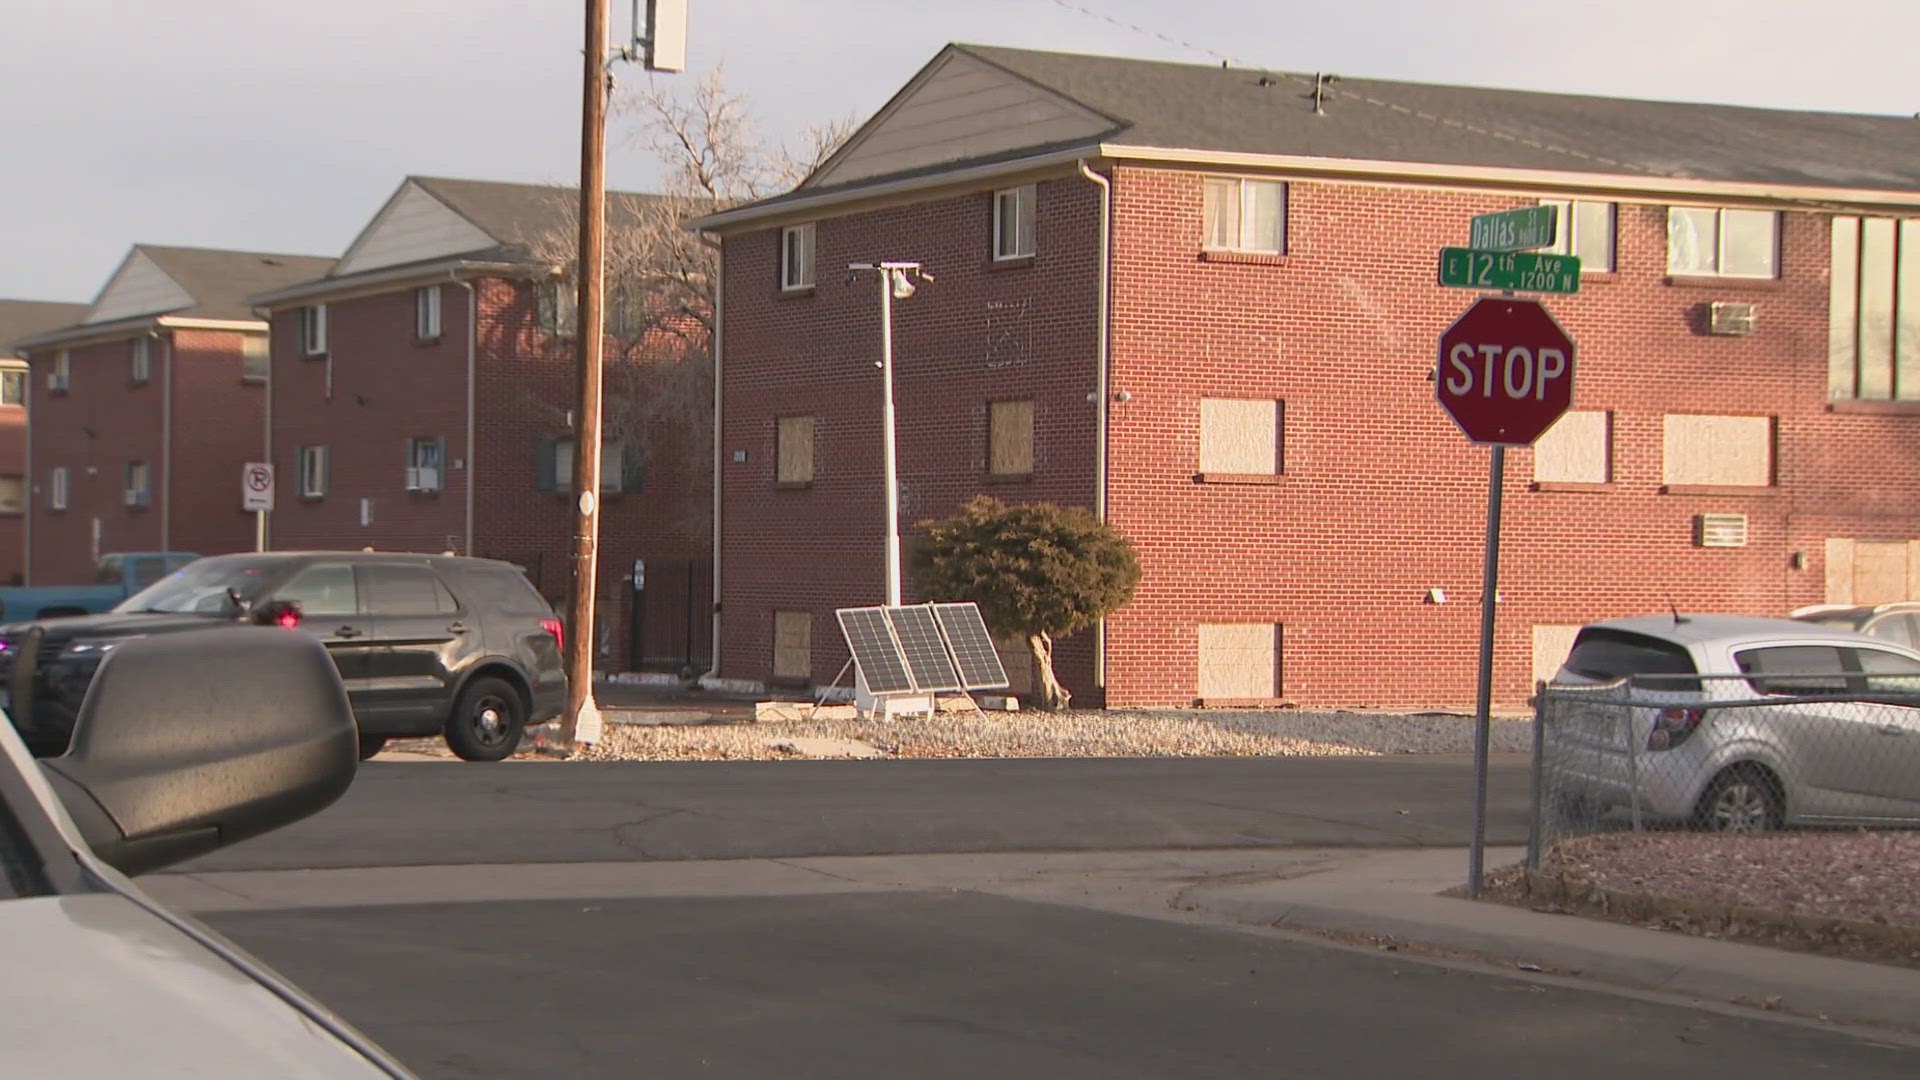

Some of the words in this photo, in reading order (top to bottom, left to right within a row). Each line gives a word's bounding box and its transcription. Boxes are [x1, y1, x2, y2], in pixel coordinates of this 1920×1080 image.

[1473, 217, 1515, 249] Dallas
[1450, 258, 1458, 276] E
[1466, 252, 1515, 285] 12th
[1534, 256, 1562, 273] Ave
[1520, 271, 1555, 290] 1200
[1563, 274, 1573, 292] N
[1446, 342, 1565, 401] STOP
